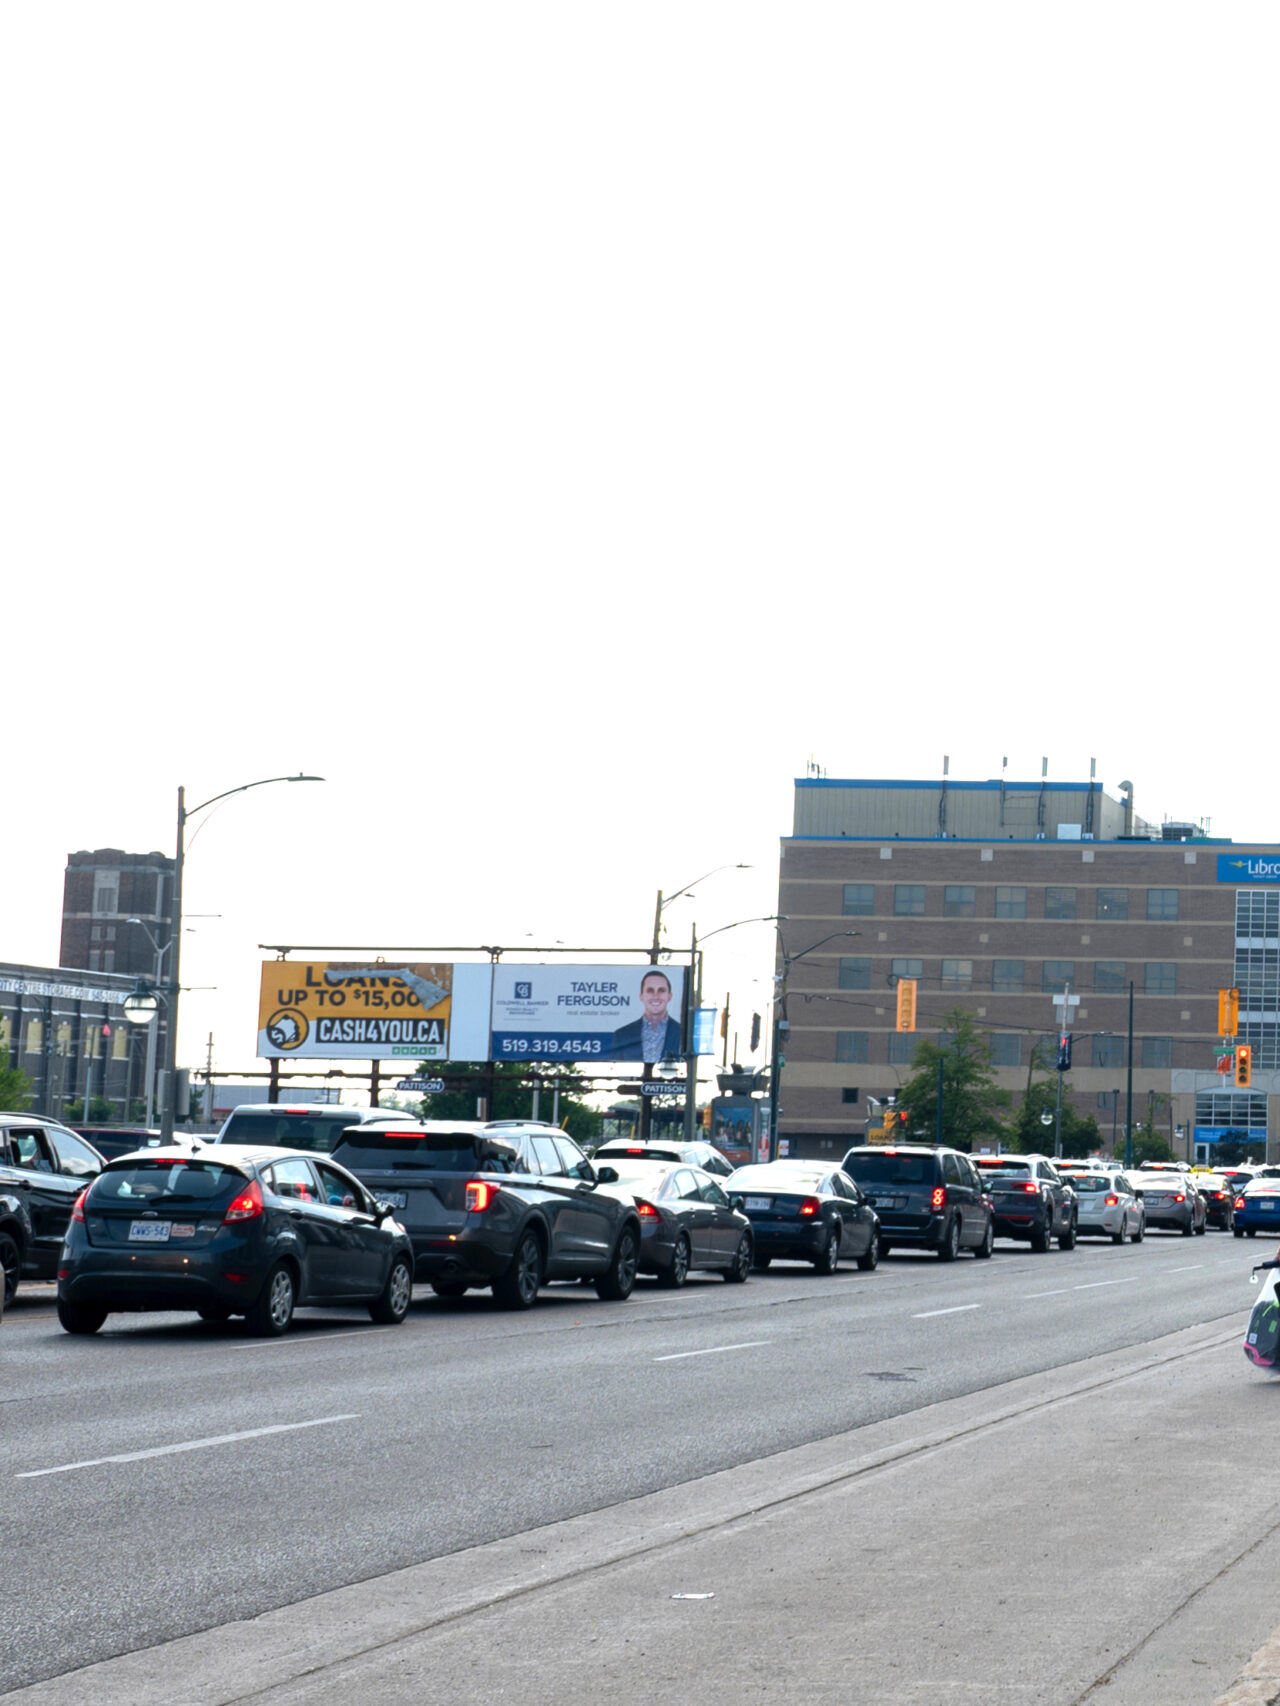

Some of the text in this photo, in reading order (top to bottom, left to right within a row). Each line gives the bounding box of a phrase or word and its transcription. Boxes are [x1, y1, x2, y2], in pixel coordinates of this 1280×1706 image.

[570, 982, 618, 993] TAYLER
[278, 989, 421, 1010] UP TO $15,00
[557, 995, 630, 1007] FERGUSON
[319, 1018, 441, 1042] CASH4YOU.CA
[502, 1039, 601, 1053] 519.319.4543
[399, 1081, 441, 1091] PATTISON
[645, 1083, 687, 1094] PATTISON
